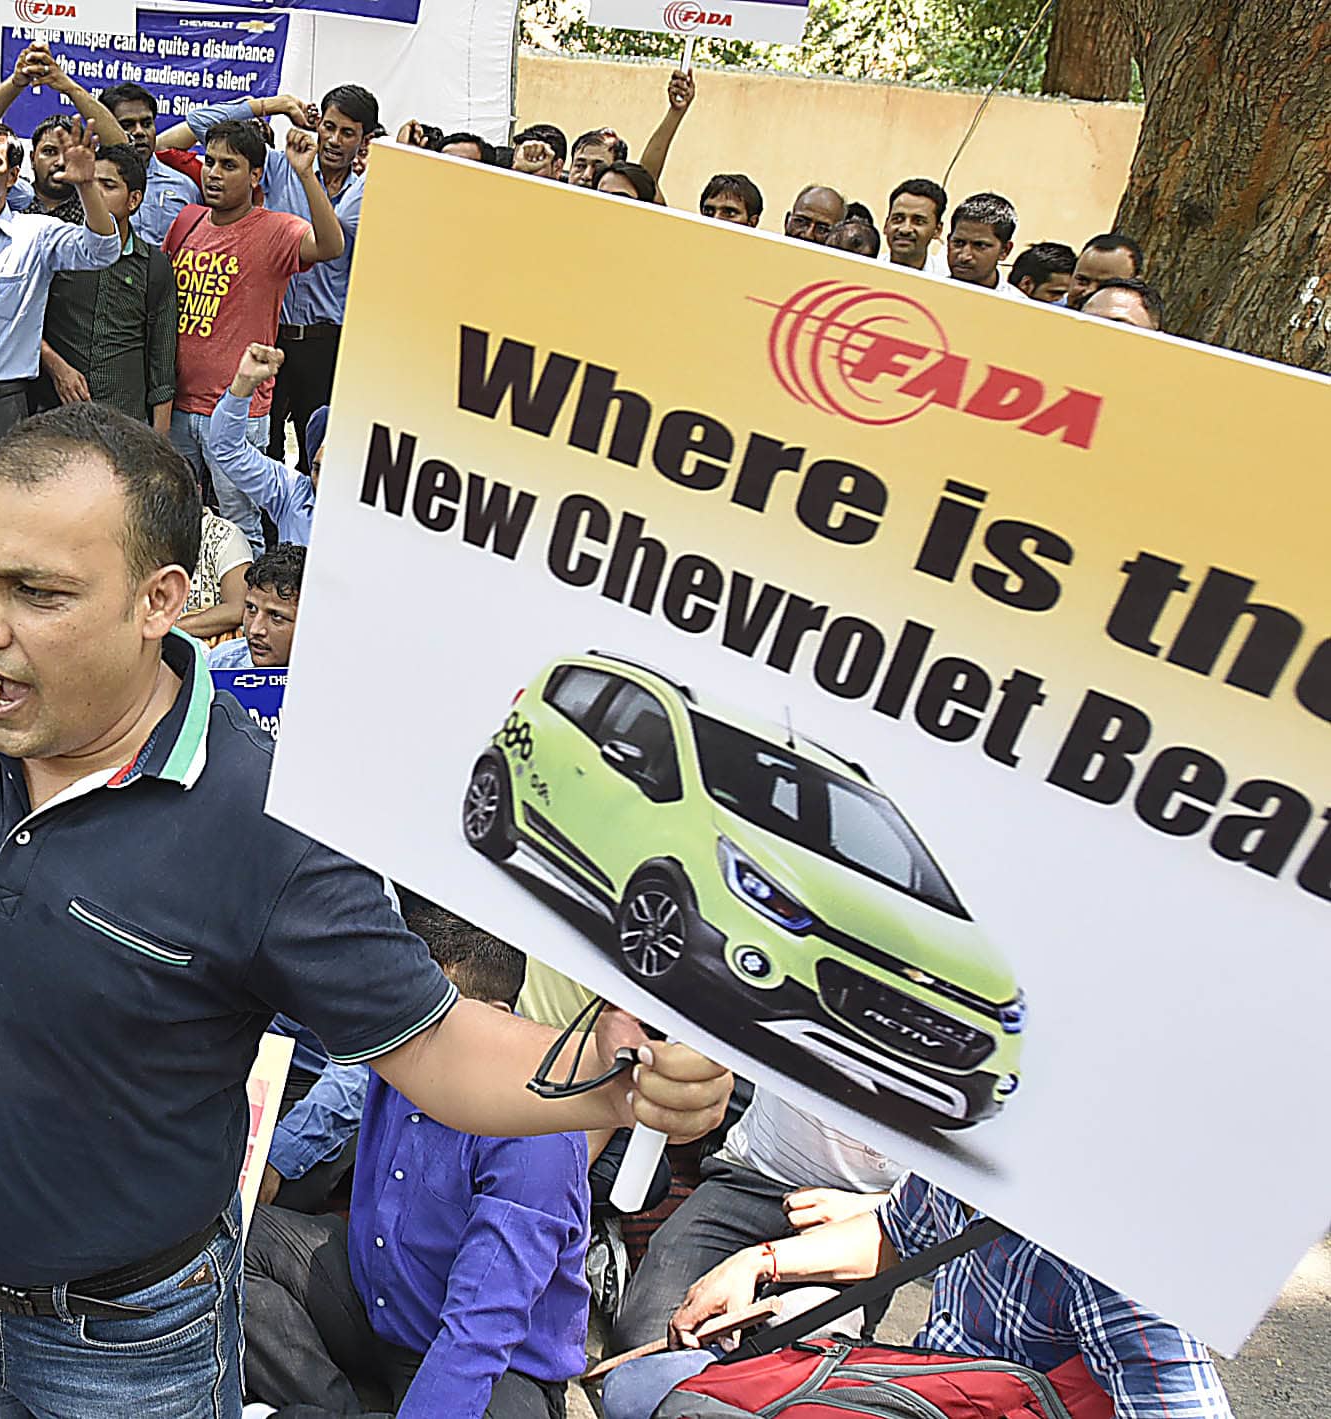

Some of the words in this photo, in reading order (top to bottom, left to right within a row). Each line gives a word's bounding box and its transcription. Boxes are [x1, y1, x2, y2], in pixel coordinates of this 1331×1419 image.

[32, 3, 76, 17] FADA
[682, 10, 733, 27] FADA
[180, 20, 234, 29] CHEVROLET
[63, 31, 112, 52] whisper
[113, 35, 137, 51] can
[139, 32, 156, 53] be
[158, 35, 190, 58] quite
[191, 41, 201, 57] a
[202, 38, 275, 63] disturbance
[56, 54, 76, 75] the
[78, 59, 103, 78] rest
[105, 60, 120, 79] of
[121, 61, 142, 82] the
[143, 65, 200, 87] audience
[172, 248, 239, 275] JACK&
[173, 269, 231, 297] ONES
[177, 291, 221, 318] ENIM
[177, 314, 214, 337] 975
[844, 329, 1106, 451] FADA
[456, 322, 890, 547] Where
[912, 478, 1075, 614] is
[358, 422, 539, 562] New
[546, 492, 1048, 770] Chevrolet
[863, 1009, 945, 1048] ACTIV
